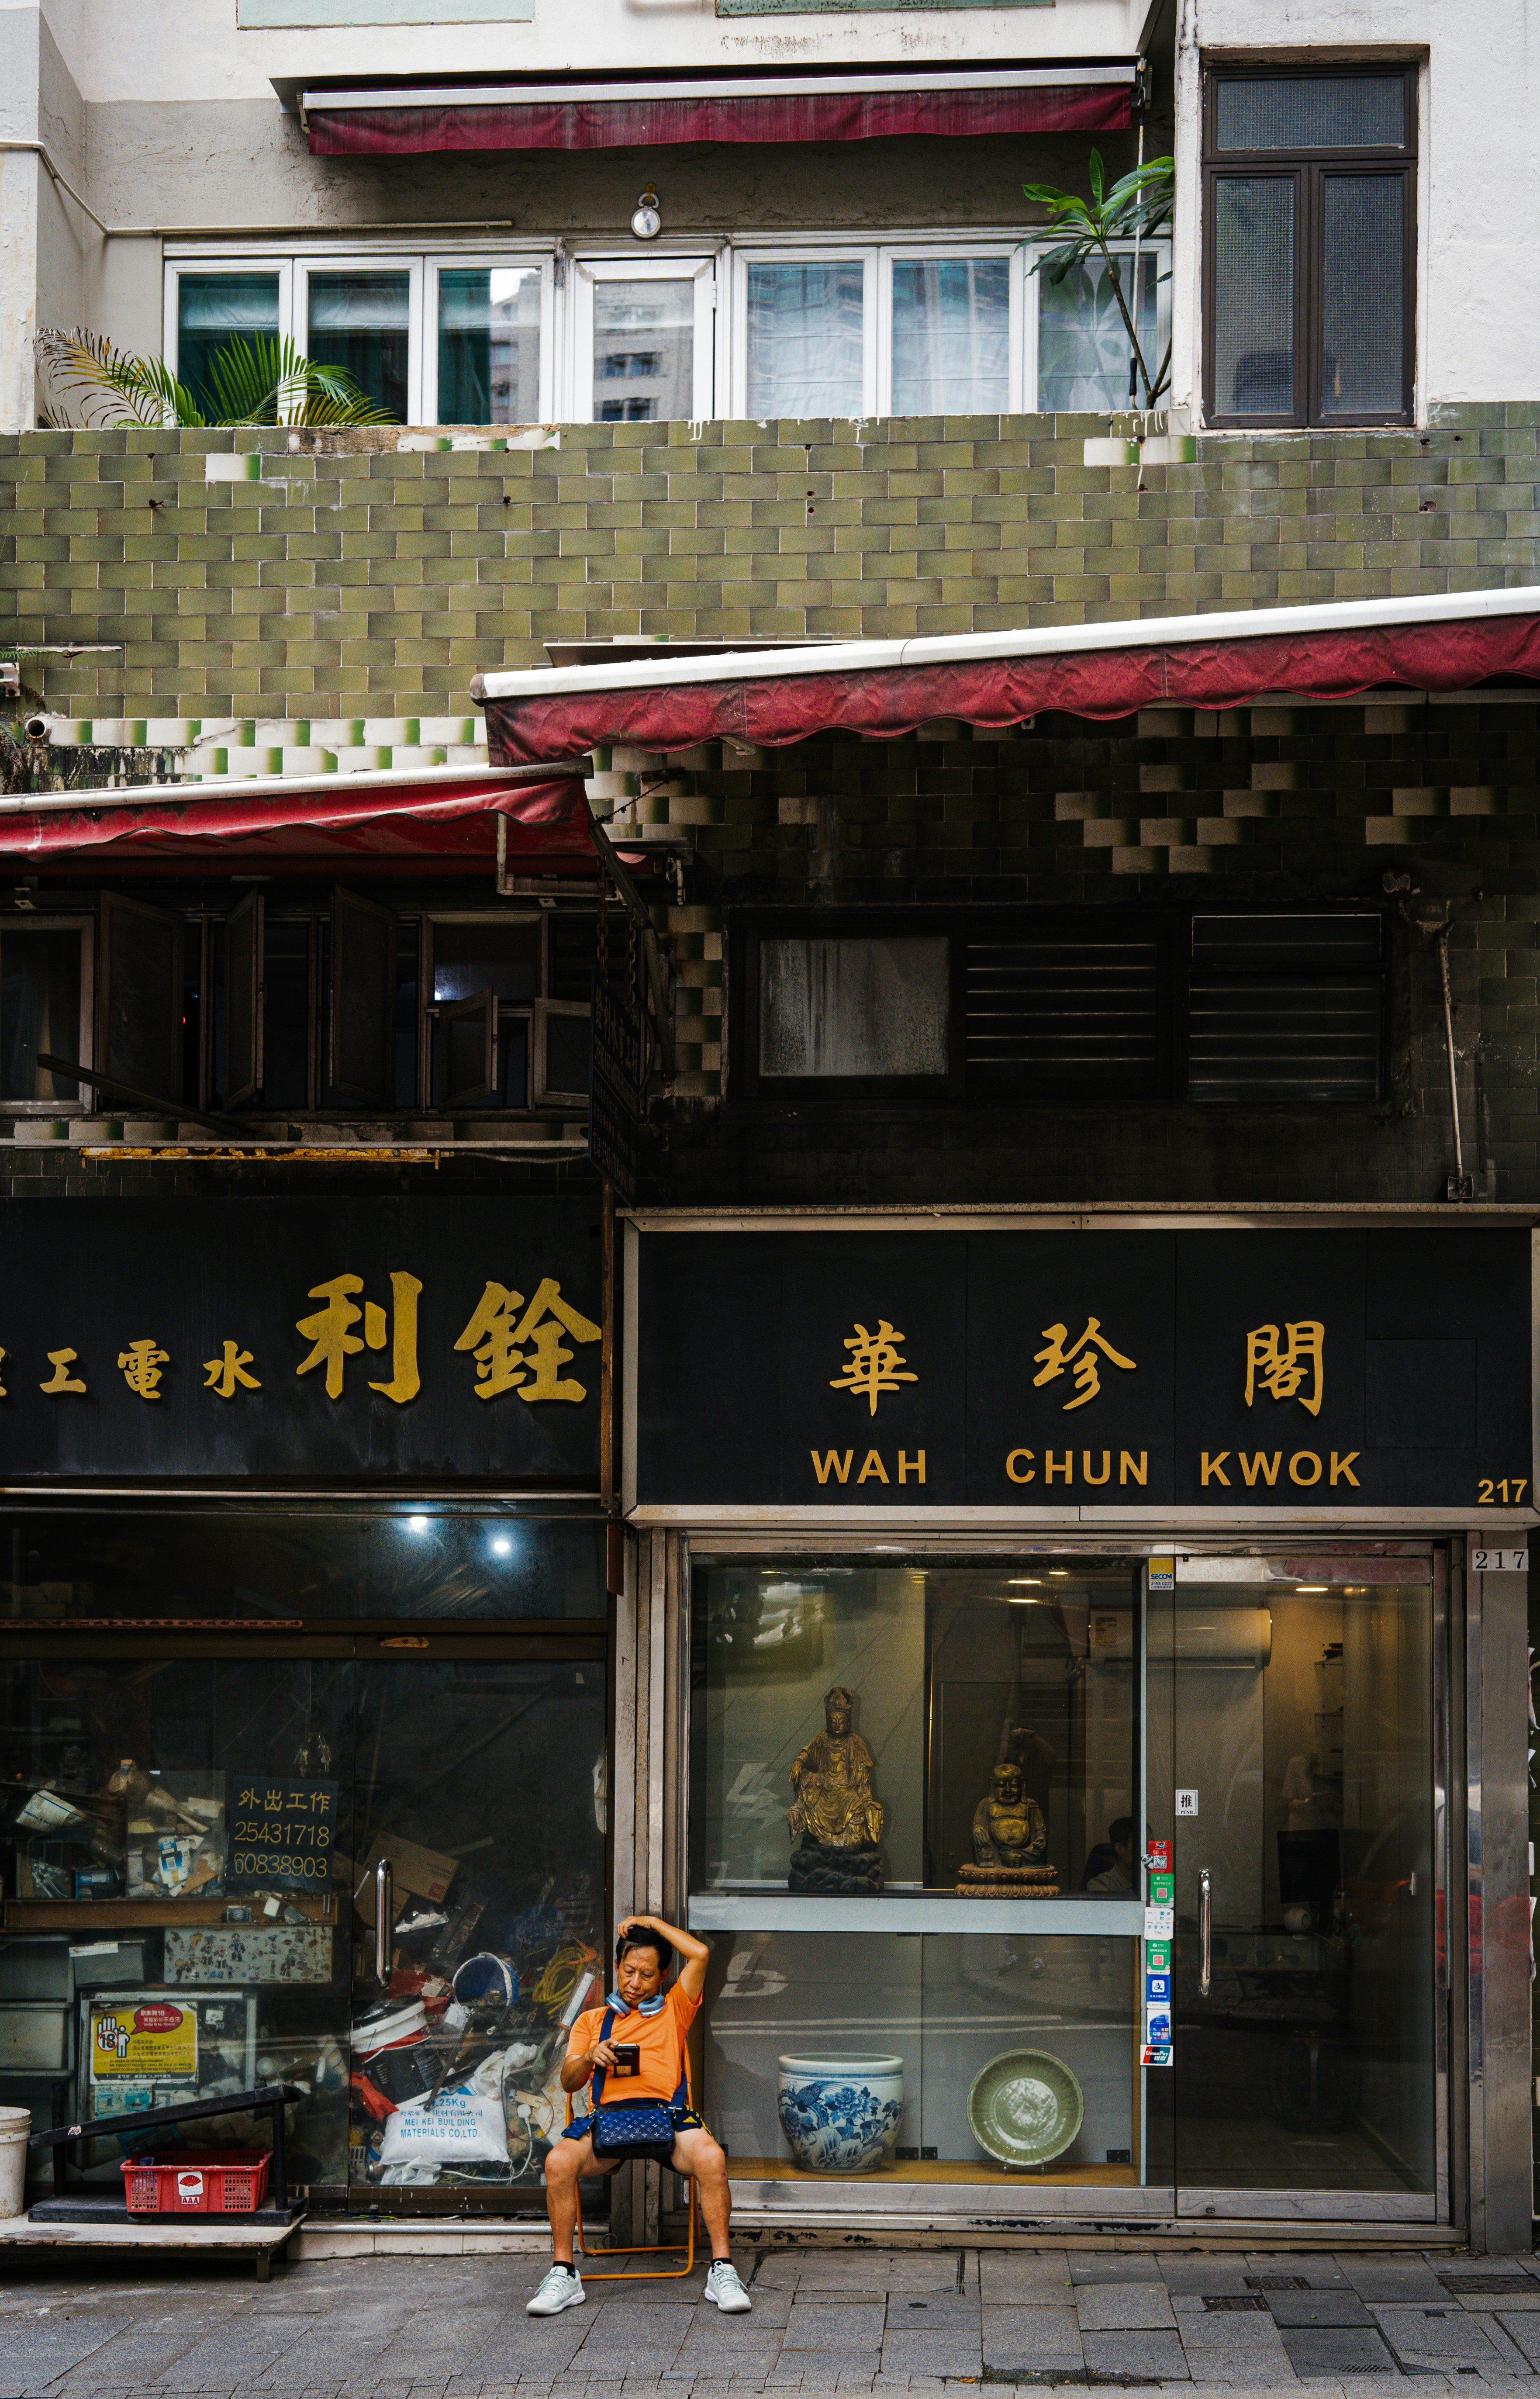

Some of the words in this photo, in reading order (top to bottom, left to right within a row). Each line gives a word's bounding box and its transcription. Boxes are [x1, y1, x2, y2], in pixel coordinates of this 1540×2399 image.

[829, 1317, 1325, 1417] 華珍閣
[811, 1449, 926, 1484] WAH
[1006, 1448, 1148, 1486] CHUN
[1201, 1451, 1360, 1486] KWOK
[1478, 1479, 1527, 1504] 217
[1475, 1551, 1525, 1569] 217
[238, 1787, 331, 1814] 外出工作
[1181, 1794, 1192, 1808] 推
[234, 1821, 329, 1847] 25431718
[234, 1853, 327, 1878] 60838903
[99, 2033, 116, 2049] 18
[401, 2128, 445, 2138] MATERIALS
